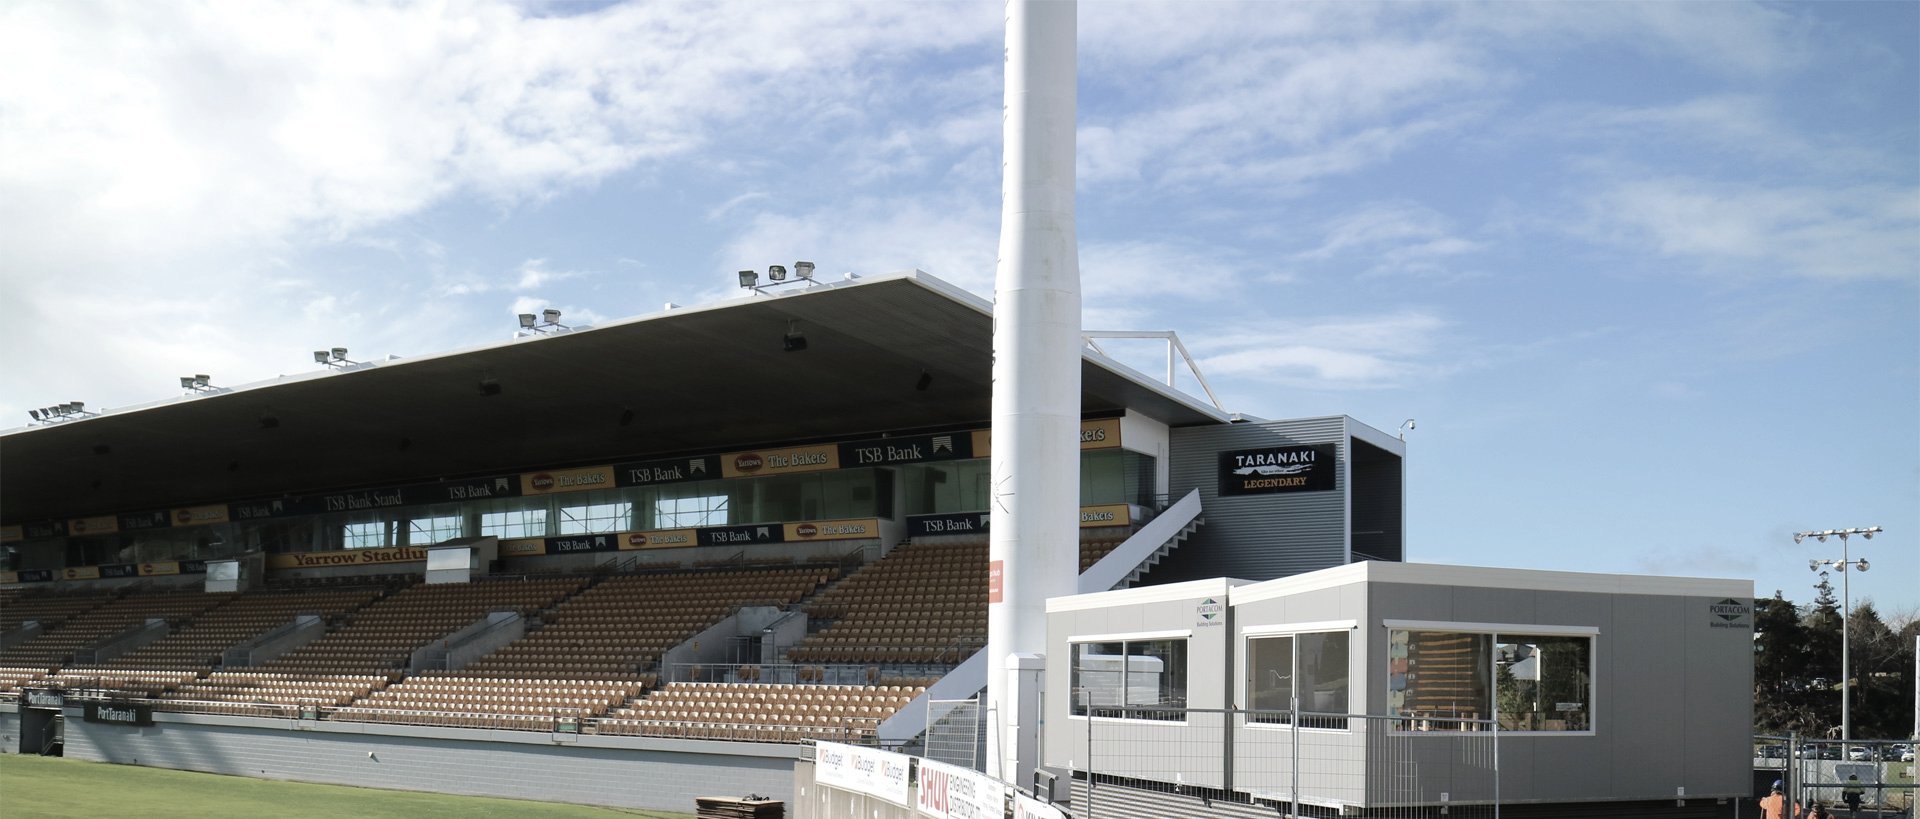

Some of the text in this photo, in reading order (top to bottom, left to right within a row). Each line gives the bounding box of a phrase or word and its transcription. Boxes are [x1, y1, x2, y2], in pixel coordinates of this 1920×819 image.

[1080, 428, 1105, 442] kers
[768, 450, 827, 468] The Bakers
[855, 444, 922, 464] TSB Bank
[1235, 450, 1315, 466] TARANAKI
[737, 458, 762, 468] Yarrows
[559, 475, 575, 487] The
[629, 466, 683, 483] TSB Bank
[1243, 477, 1307, 489] LEGENDARY
[448, 484, 492, 499] TSB Bank
[324, 488, 403, 511] TSB Bank Stand
[1081, 511, 1114, 522] Bakers
[822, 524, 865, 535] The Bakers
[923, 518, 974, 532] TSB Bank
[710, 530, 751, 543] TSB Bank
[556, 540, 591, 551] TSB Bank
[294, 548, 427, 566] Yarrow Stadiu
[1196, 605, 1222, 614] PORTACOM
[1710, 605, 1750, 614] PORTACOM
